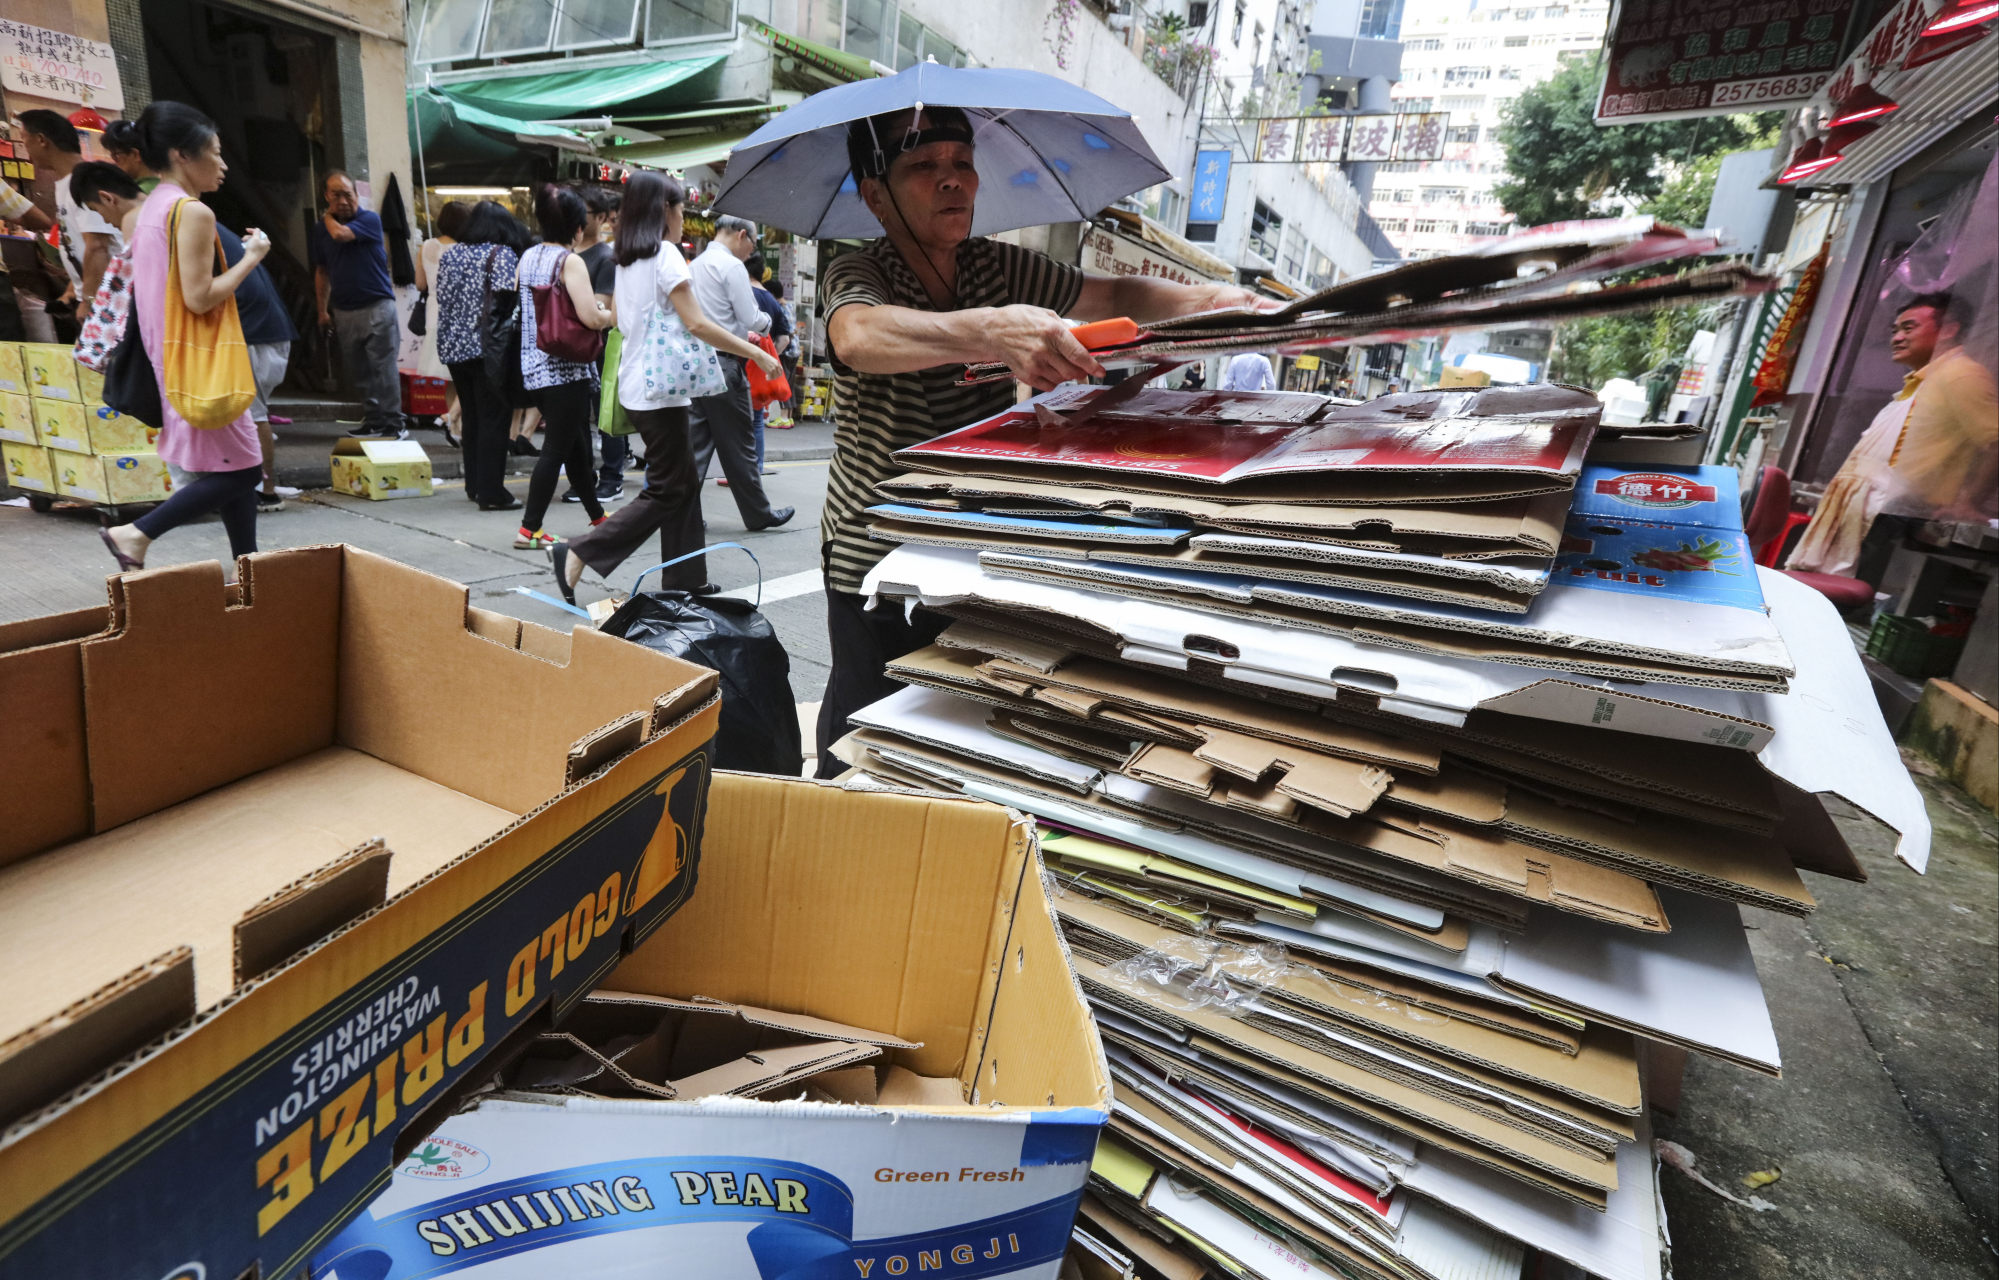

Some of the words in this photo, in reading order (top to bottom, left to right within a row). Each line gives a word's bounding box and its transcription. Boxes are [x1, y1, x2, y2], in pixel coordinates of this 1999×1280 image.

[37, 58, 68, 77] 700
[1714, 74, 1828, 103] 25756838
[1261, 117, 1442, 159] 景祥玻璃
[1200, 160, 1220, 214] 新時代
[945, 445, 1086, 461] AUSTRALIAN
[1091, 457, 1182, 471] CITRUS
[1618, 482, 1693, 500] 德竹
[505, 870, 622, 1018] GOLD
[292, 975, 419, 1086] CHERRIES
[255, 985, 440, 1147] WASHINGTON
[256, 979, 488, 1239] PRIZE
[454, 1142, 480, 1157] SALE
[874, 1167, 950, 1183] Green
[958, 1167, 1025, 1183] Fresh
[416, 1176, 655, 1256] SHUIJING
[670, 1171, 811, 1214] PEAR
[853, 1232, 1020, 1279] YONGJI
